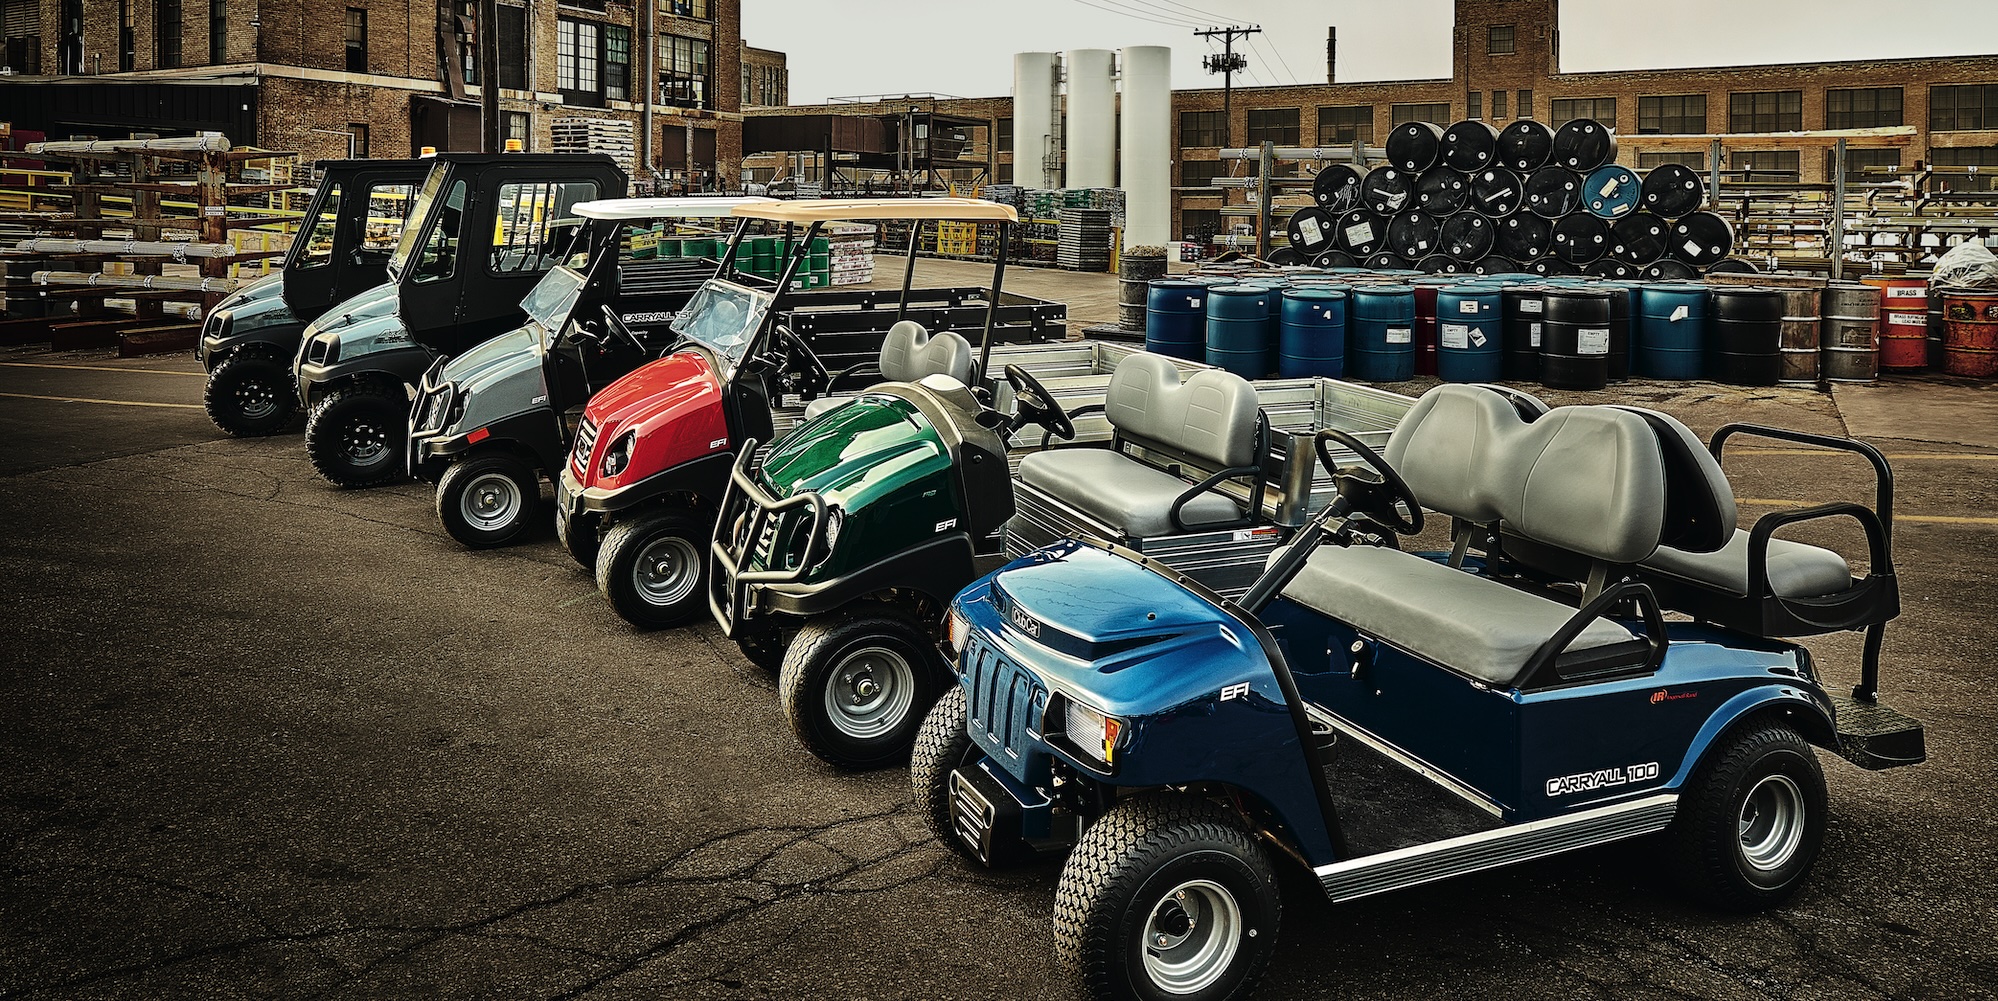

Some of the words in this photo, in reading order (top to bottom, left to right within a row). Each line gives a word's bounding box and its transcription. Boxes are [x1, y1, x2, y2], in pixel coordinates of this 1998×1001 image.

[622, 311, 676, 323] CARRYALL
[531, 394, 547, 405] EFI
[710, 437, 727, 449] EFI
[935, 517, 957, 532] EFI
[1220, 681, 1250, 701] EFI
[1546, 767, 1627, 797] CARRYALL
[1627, 761, 1659, 783] 100
